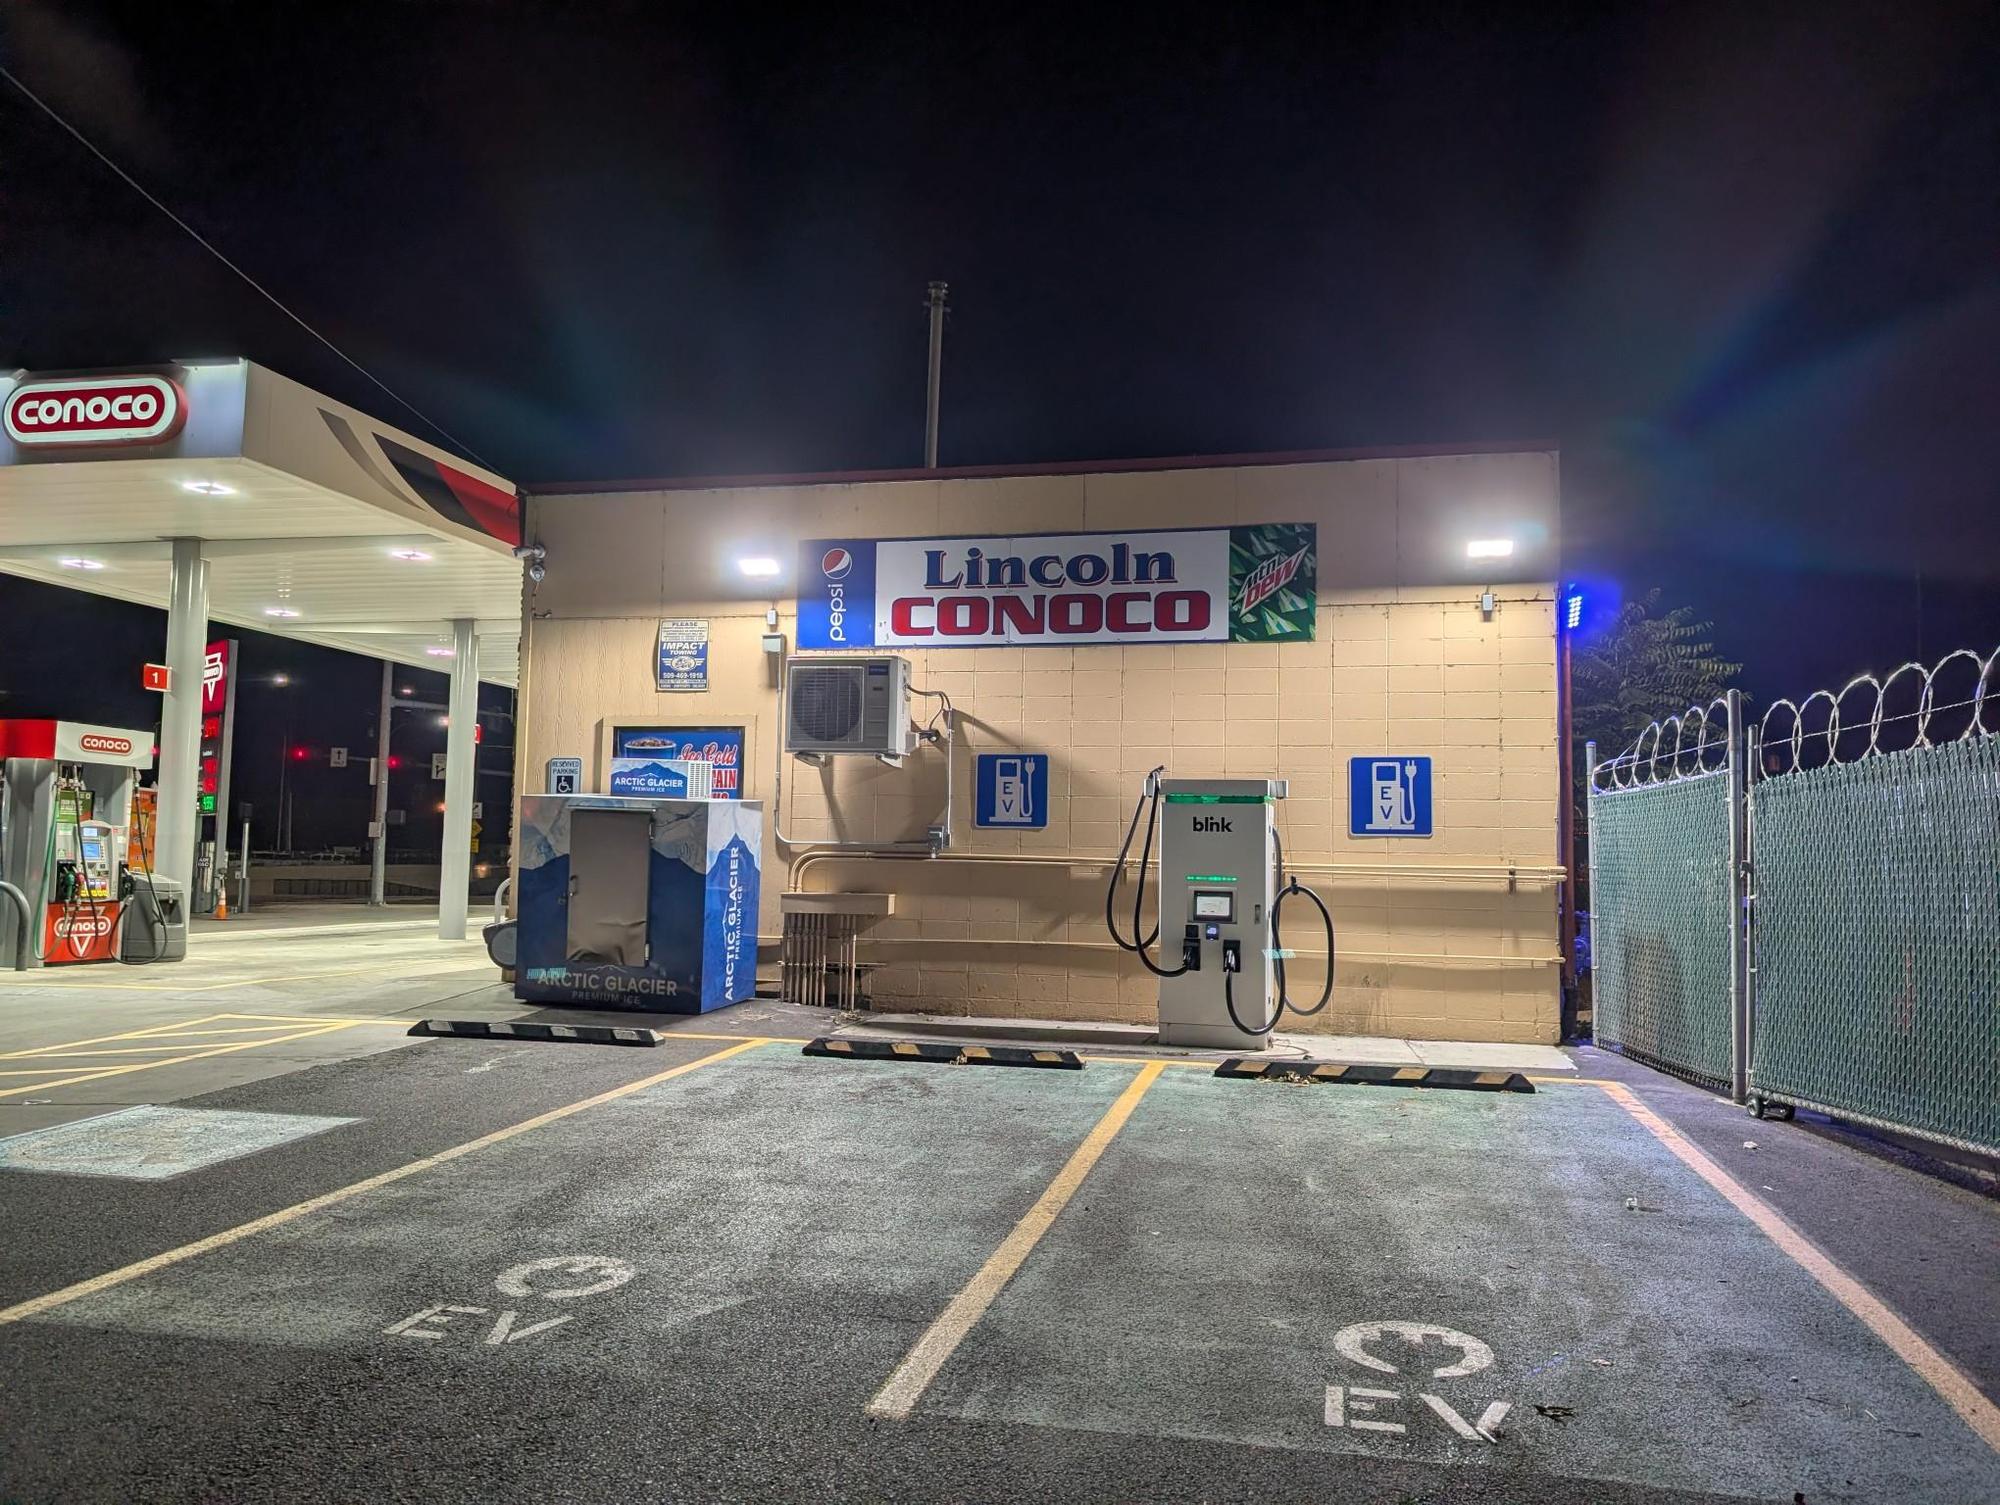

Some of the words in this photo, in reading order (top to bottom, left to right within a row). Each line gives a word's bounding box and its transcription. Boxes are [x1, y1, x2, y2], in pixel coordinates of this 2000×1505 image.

[923, 542, 1178, 590] Lincoln
[828, 583, 847, 641] pepsi
[891, 590, 1211, 637] CONOCO
[662, 642, 705, 650] IMPACT
[152, 672, 159, 684] 1
[677, 744, 703, 760] Ice
[703, 742, 738, 765] Cold
[615, 776, 646, 787] ARCTIC
[647, 778, 683, 788] GLACIER
[1192, 816, 1233, 833] blink
[728, 846, 739, 925] GLACIER
[734, 907, 742, 960] PREMIUM
[537, 968, 600, 990] ARCTIC
[605, 976, 677, 995] GLACIER
[724, 931, 736, 1001] ARCTIC
[572, 990, 620, 1003] PREMIUM
[623, 996, 640, 1004] ICE
[1324, 1384, 1514, 1444] EV
